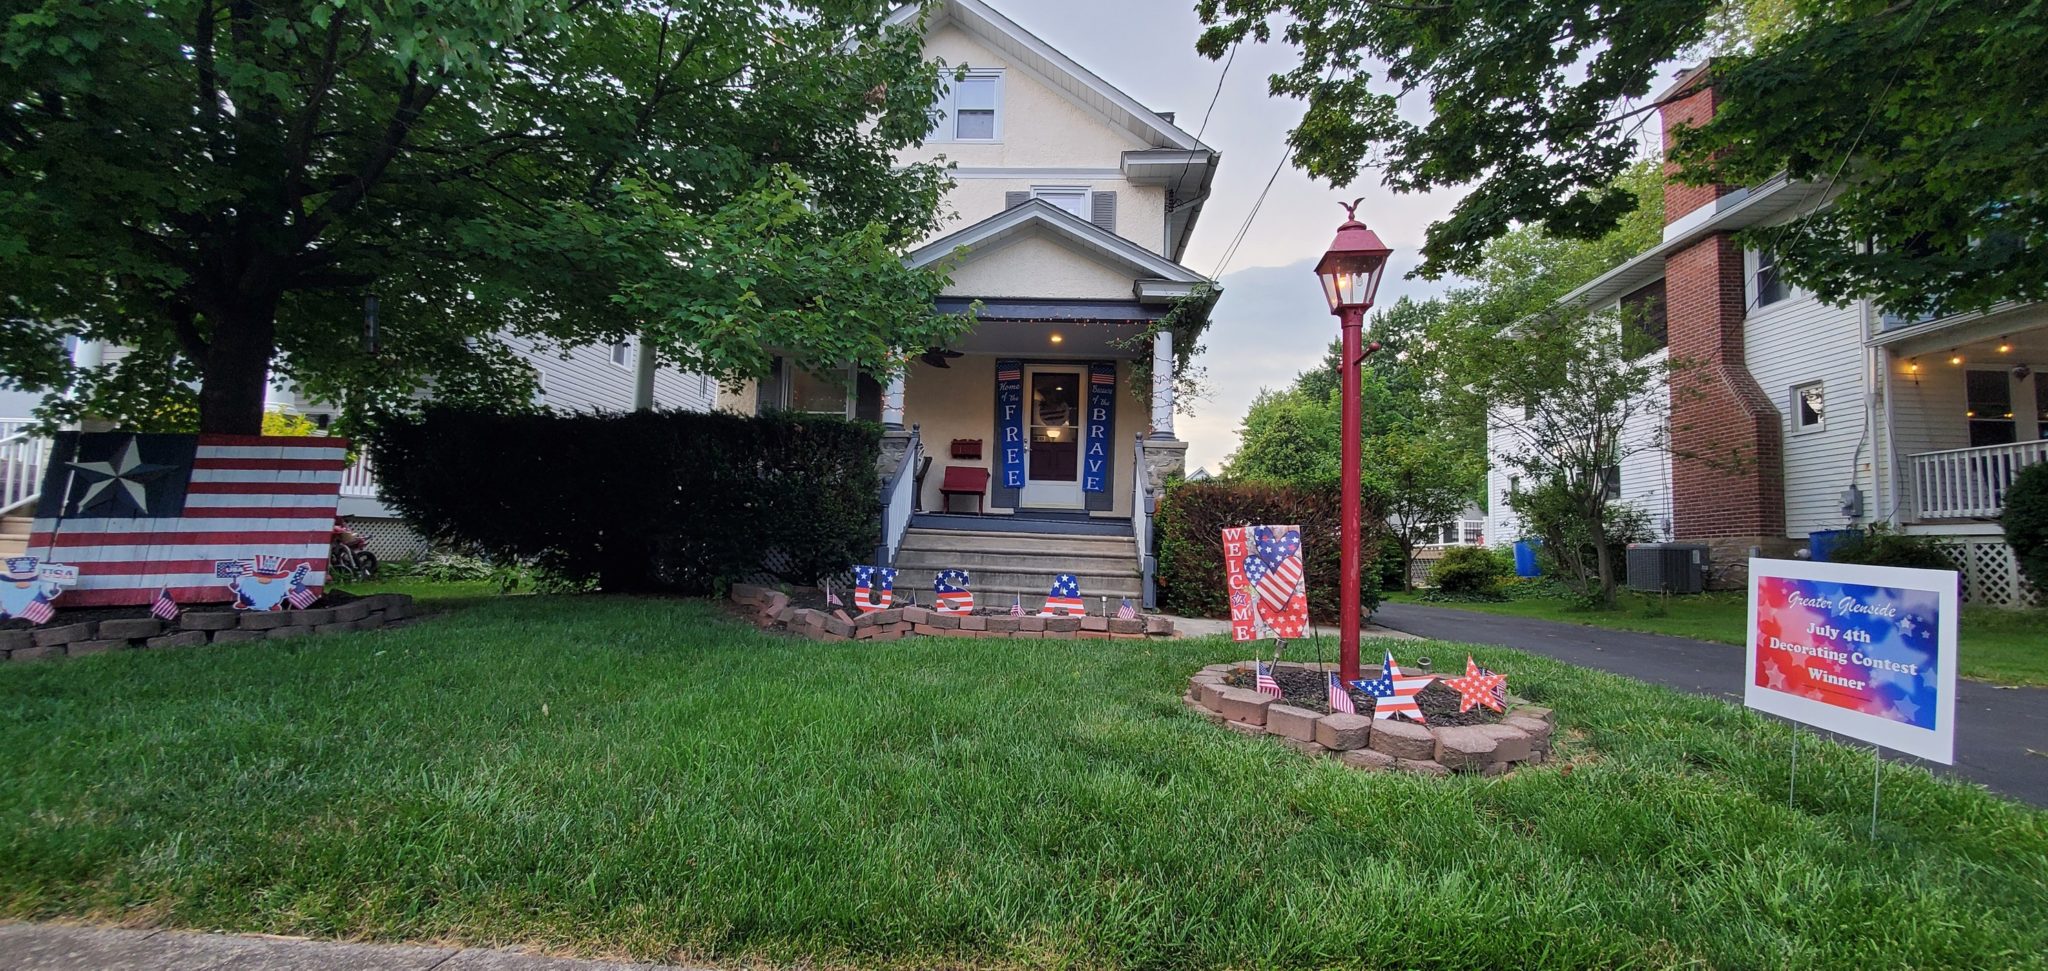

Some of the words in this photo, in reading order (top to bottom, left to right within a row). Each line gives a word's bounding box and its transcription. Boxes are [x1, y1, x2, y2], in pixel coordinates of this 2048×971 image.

[999, 382, 1020, 391] Home
[1001, 392, 1008, 402] of
[1092, 395, 1099, 405] of
[1004, 405, 1021, 486] FREE
[1087, 408, 1106, 490] BRAVE
[42, 568, 73, 578] USA
[1788, 591, 1833, 609] Greater
[1838, 596, 1897, 617] Glenside
[1806, 622, 1840, 640] July
[1842, 628, 1871, 643] 4th
[1769, 638, 1848, 665] Decorating
[1851, 653, 1918, 676] Contest
[1808, 667, 1866, 690] Winner
